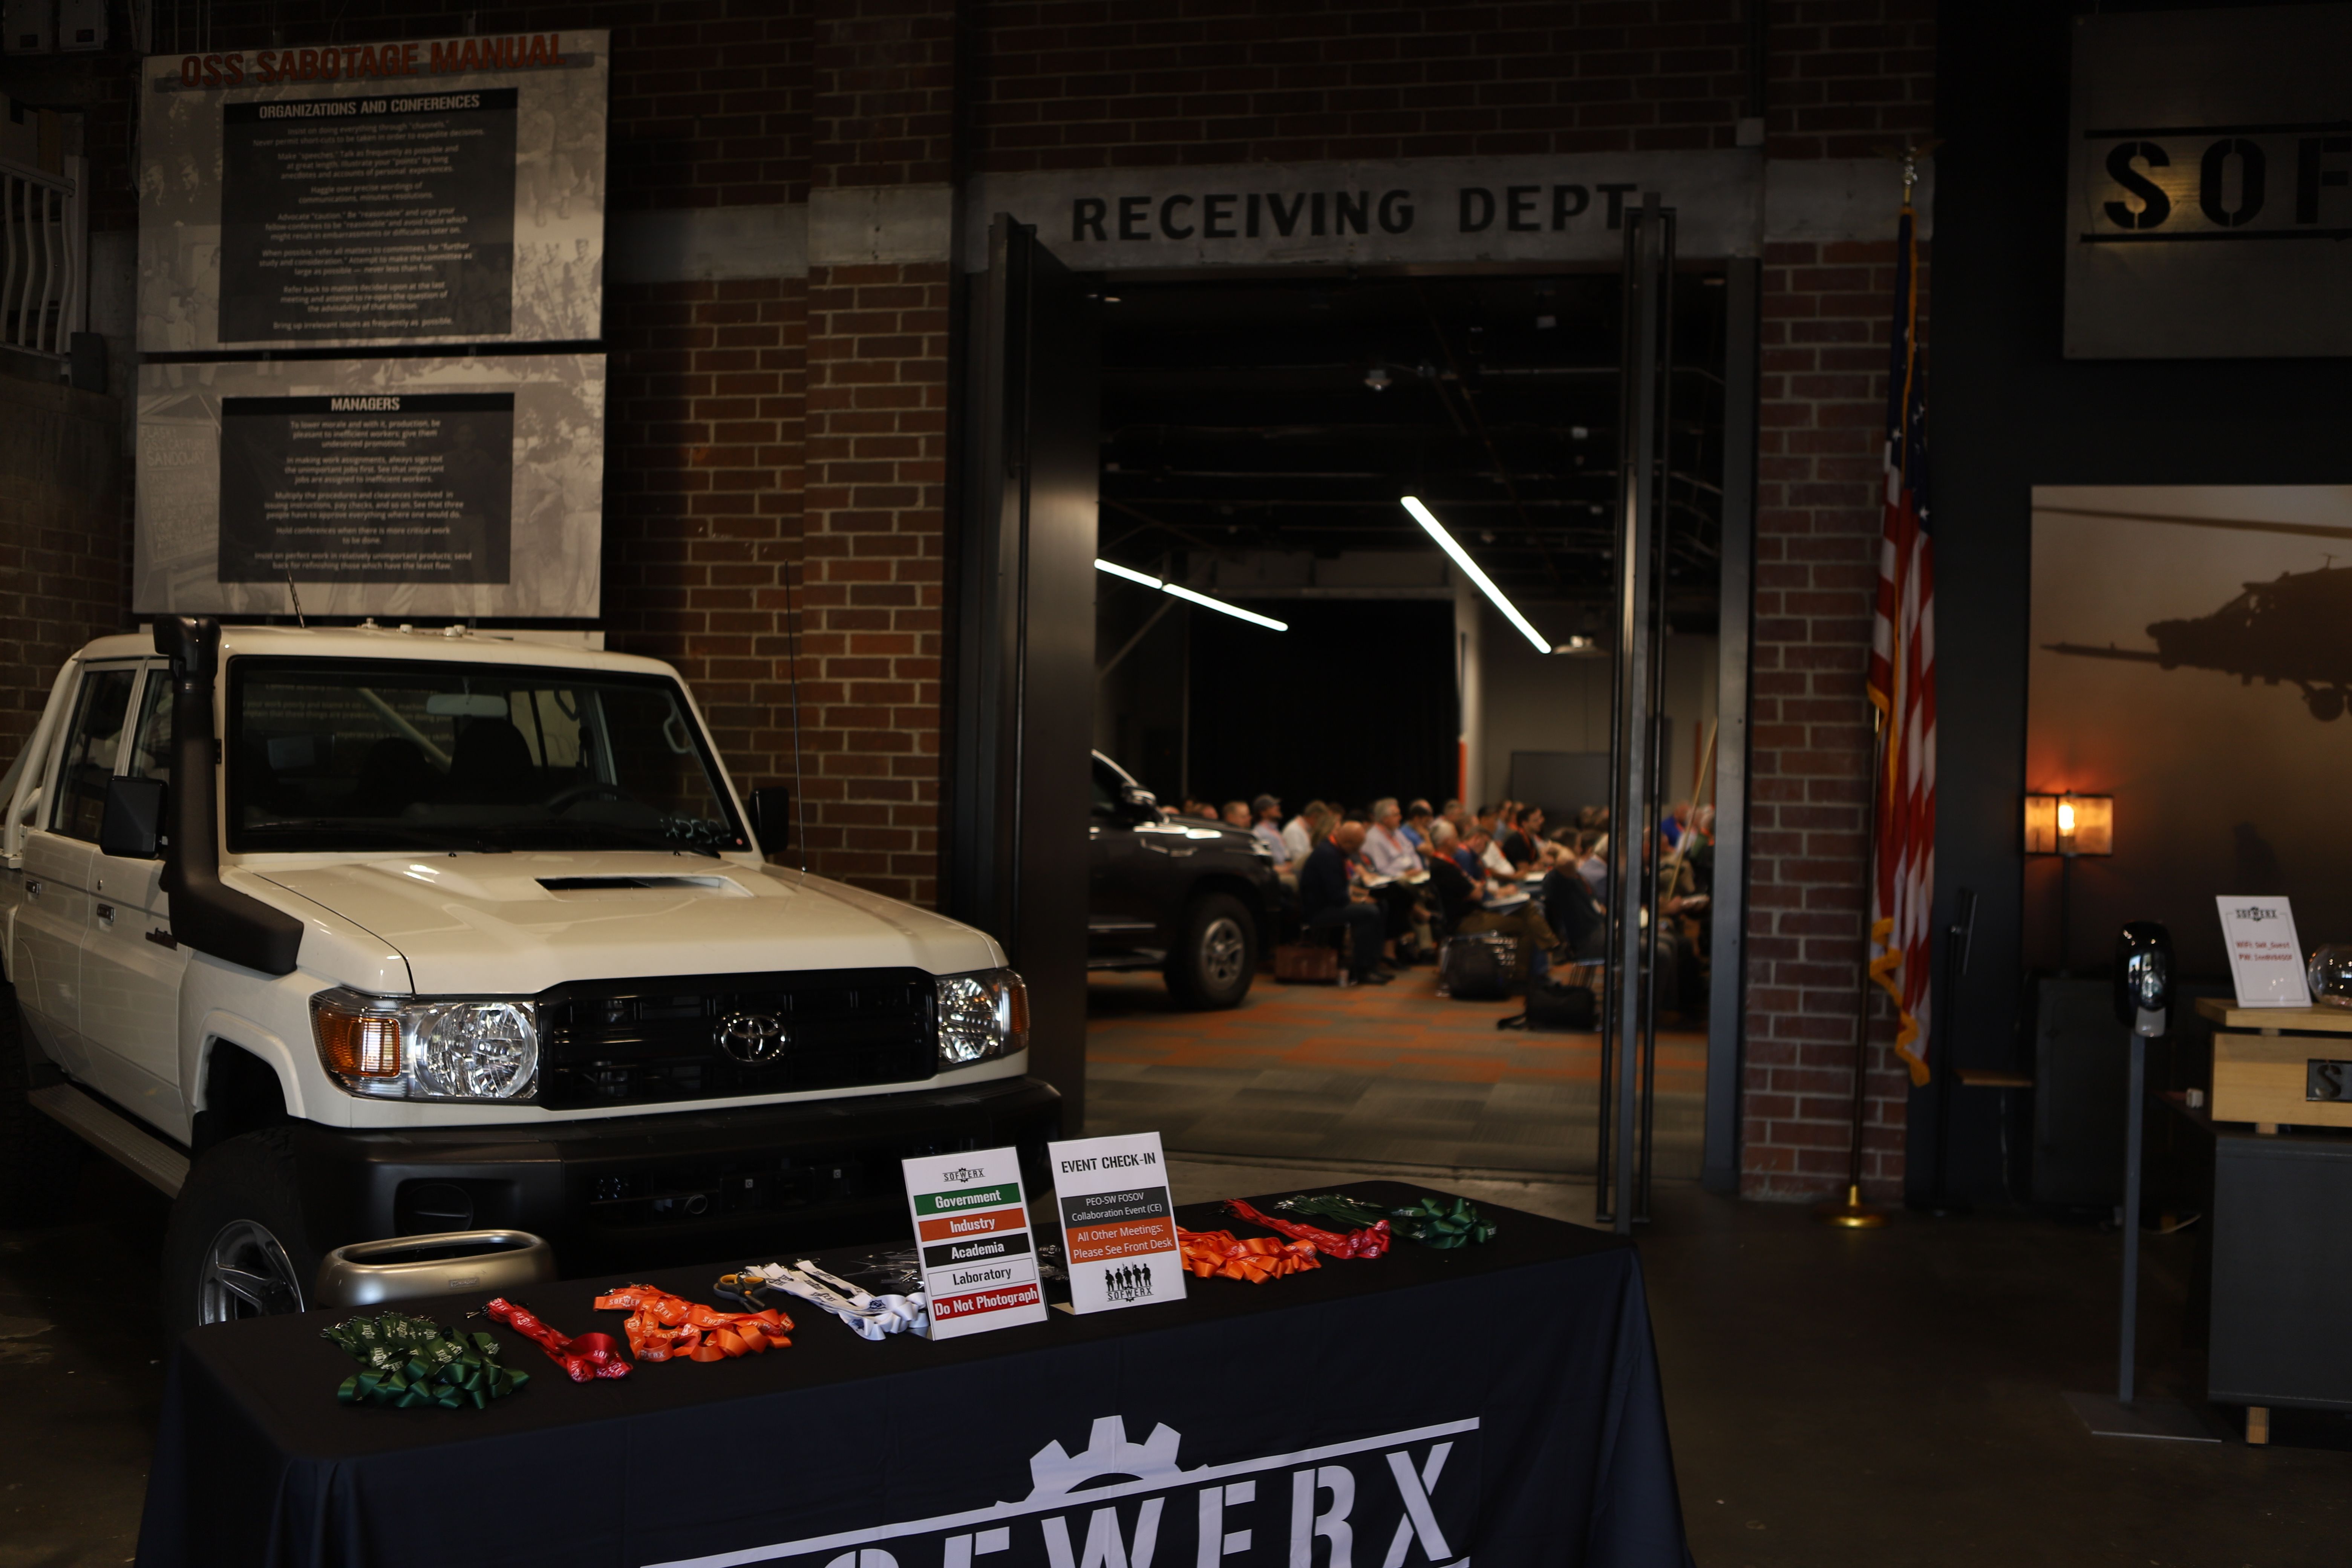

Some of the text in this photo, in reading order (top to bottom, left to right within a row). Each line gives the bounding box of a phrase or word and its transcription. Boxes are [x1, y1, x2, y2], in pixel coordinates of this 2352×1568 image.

[182, 34, 565, 87] OSS SABOTAGE MANUAL
[259, 94, 480, 119] ORGANIZATIONS AND CONFERENCES
[2104, 137, 2352, 228] SOF
[1072, 190, 1414, 242] RECEIVING
[331, 396, 401, 412] MANAGERS
[1061, 1152, 1156, 1173] EVENT CHECK-IN
[943, 1169, 985, 1181] SOFWERX
[935, 1190, 1002, 1209] Government
[1086, 1192, 1144, 1207] PEO-SW FOSOV
[1072, 1203, 1162, 1222] Collaboration Event (CE)
[949, 1218, 995, 1233] Industry
[1078, 1225, 1164, 1242] All Other Meetings:
[951, 1241, 1005, 1260] Academia
[1073, 1237, 1173, 1259] Please See Front Desk
[952, 1269, 1011, 1285] Laboratory
[934, 1287, 1038, 1316] Do Not Photograph
[1107, 1287, 1152, 1300] SOFWERX
